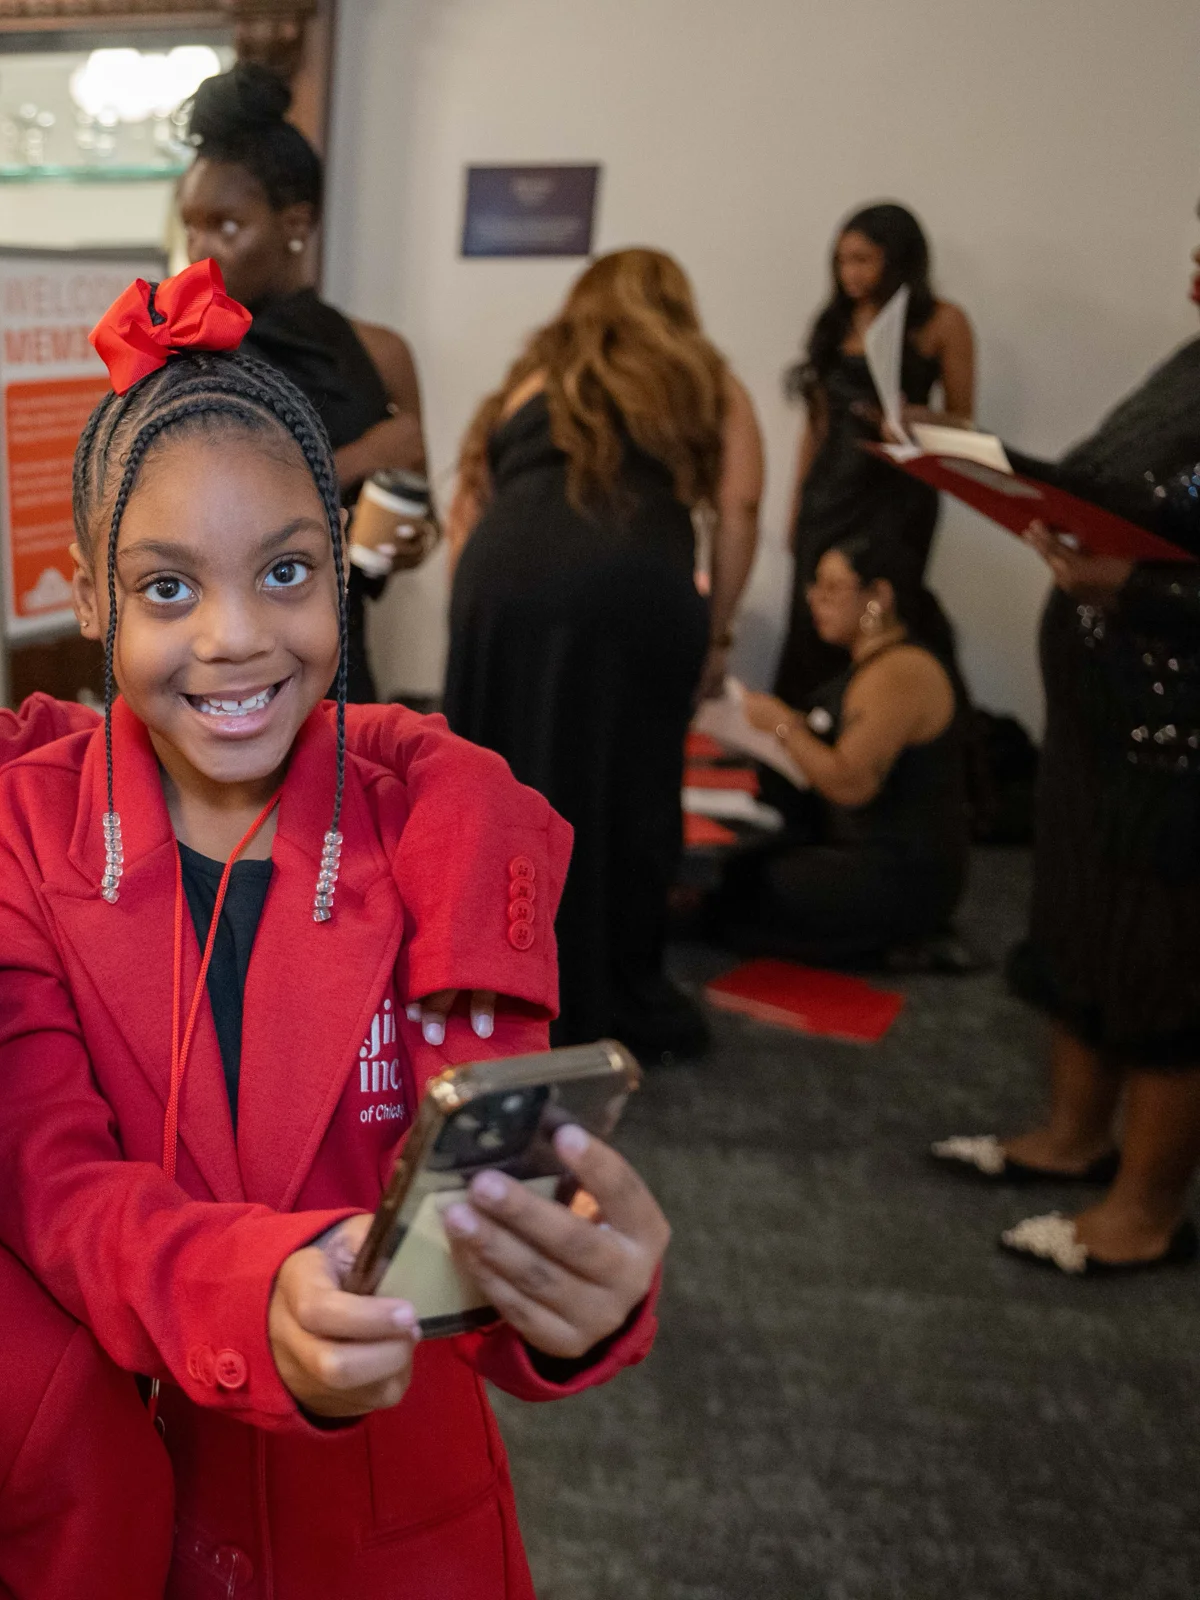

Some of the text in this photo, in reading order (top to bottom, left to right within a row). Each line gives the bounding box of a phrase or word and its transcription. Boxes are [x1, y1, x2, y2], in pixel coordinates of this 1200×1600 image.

[4, 275, 125, 317] WELCO
[360, 1102, 405, 1123] of Chica
